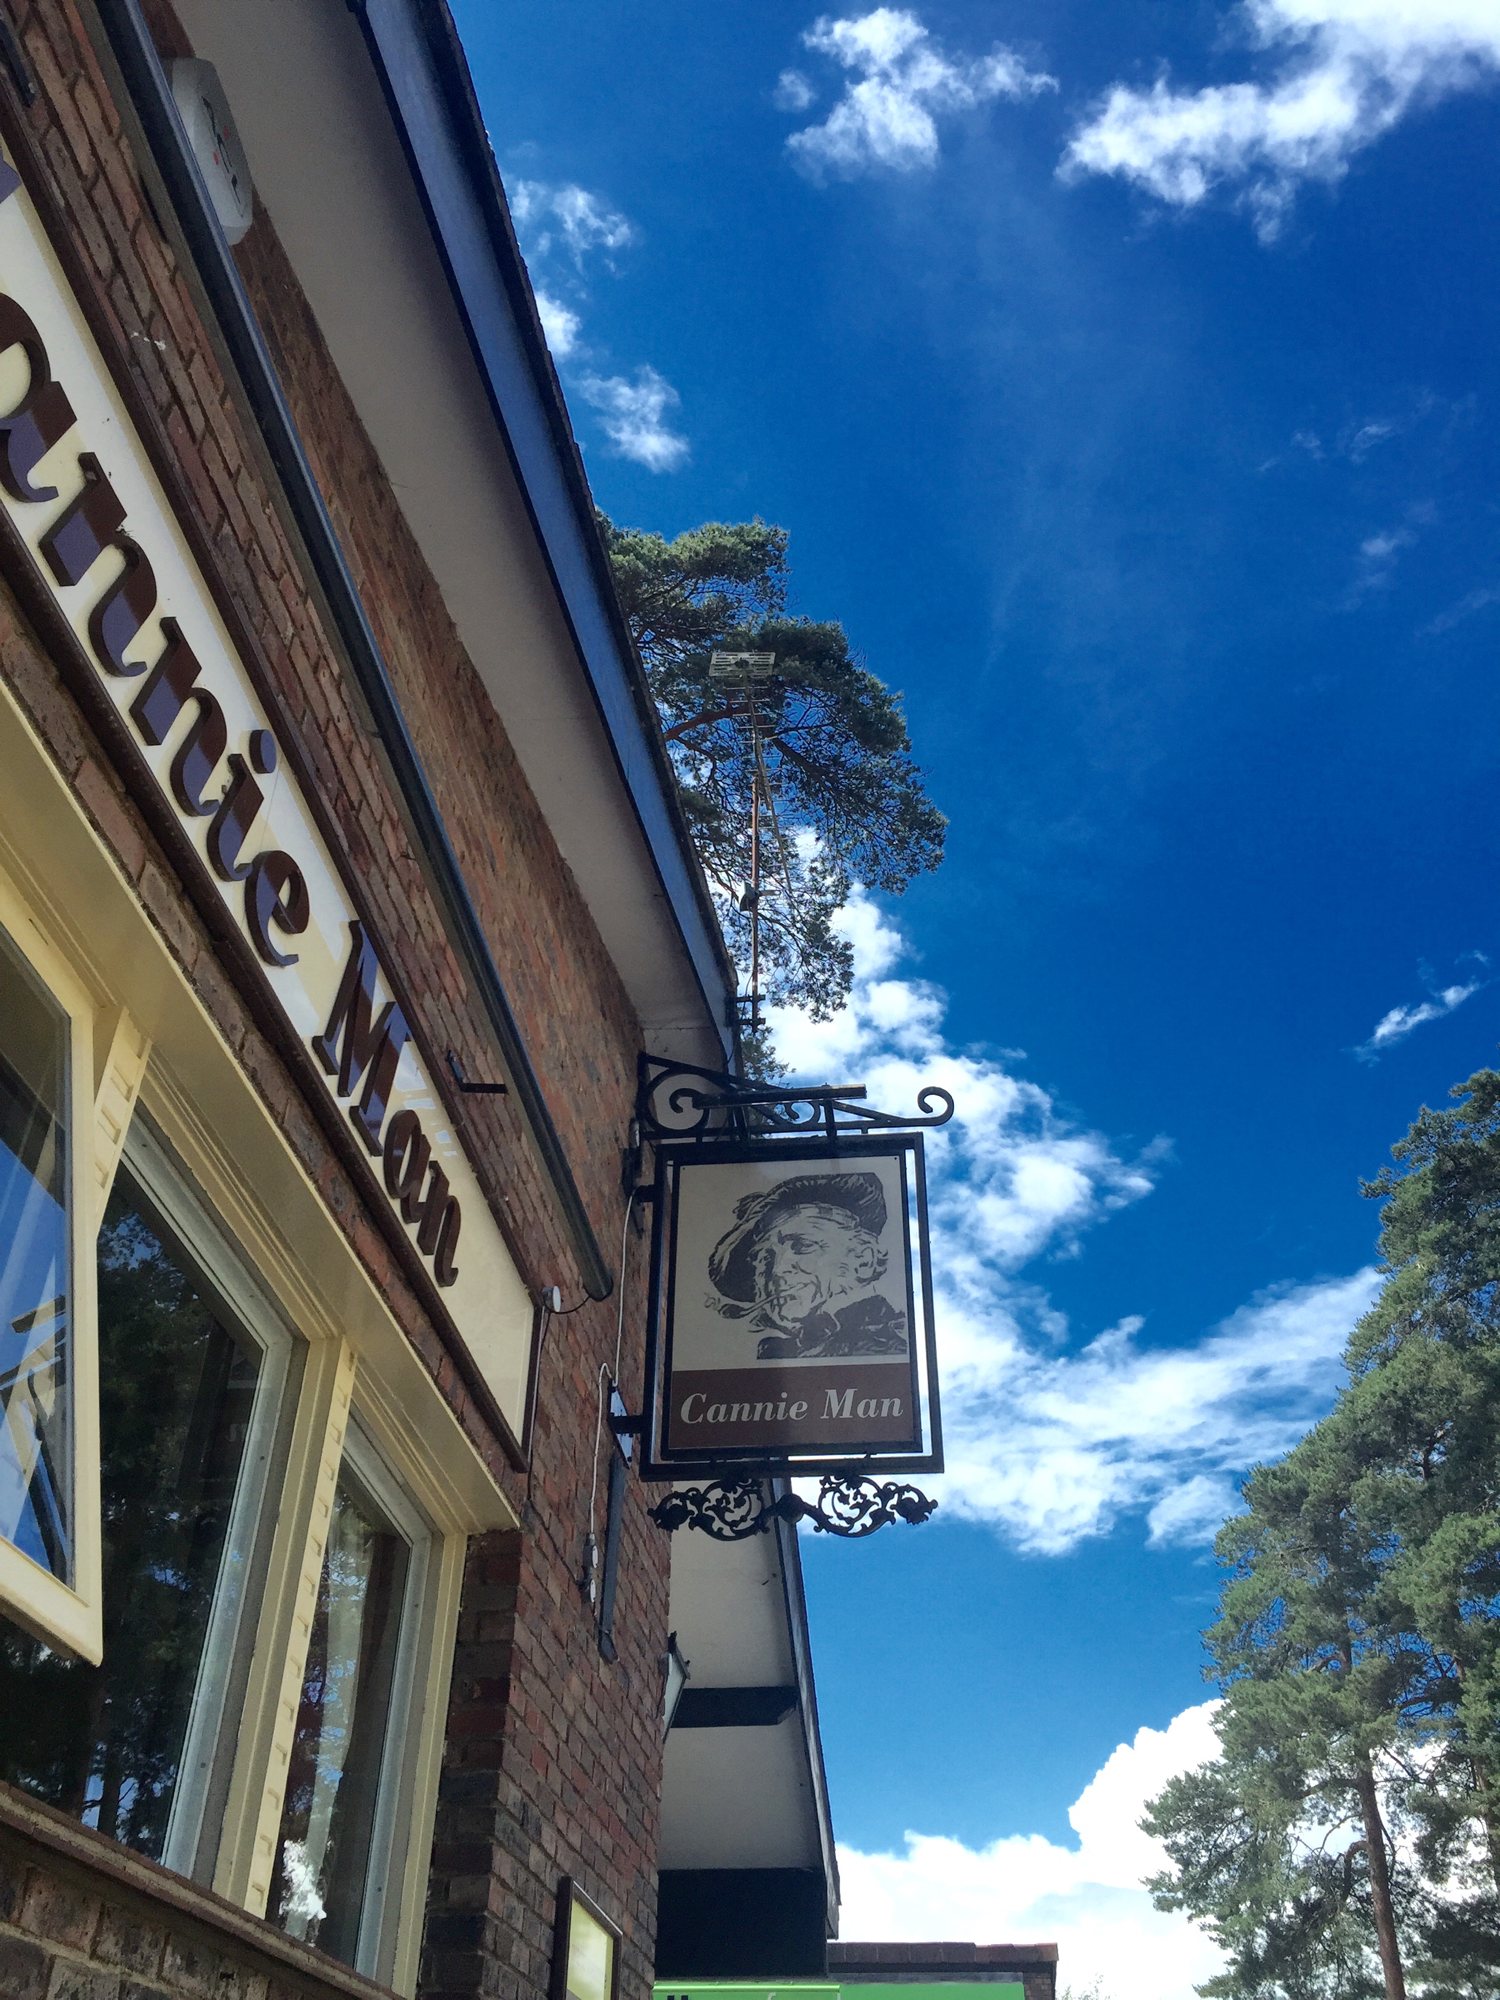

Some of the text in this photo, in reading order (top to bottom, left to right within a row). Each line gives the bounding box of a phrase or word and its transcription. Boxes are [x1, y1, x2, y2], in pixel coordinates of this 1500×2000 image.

[0, 145, 461, 1287] annie Man
[680, 1388, 904, 1424] Cannie Man
